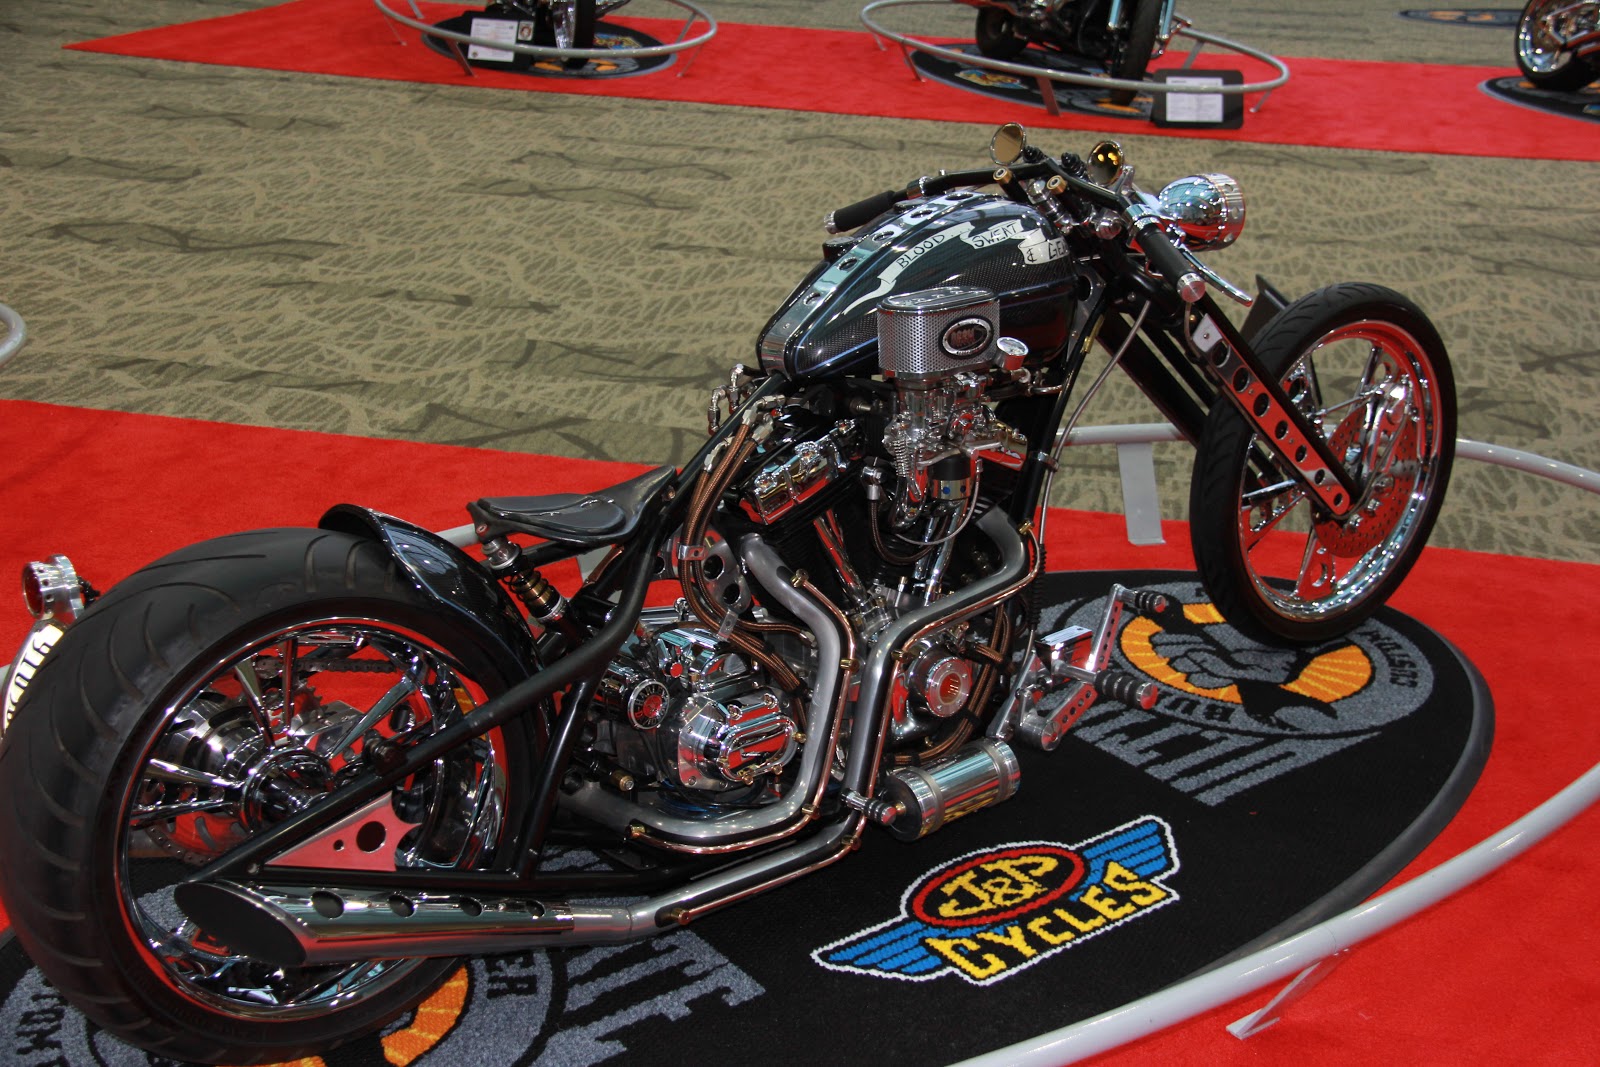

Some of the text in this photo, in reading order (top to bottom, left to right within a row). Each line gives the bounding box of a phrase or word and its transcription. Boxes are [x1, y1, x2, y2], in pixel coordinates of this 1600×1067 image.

[896, 234, 945, 269] BLOOD
[971, 222, 1018, 248] SWEAT
[938, 855, 1058, 918] J&P
[924, 860, 1168, 980] CYCLES
